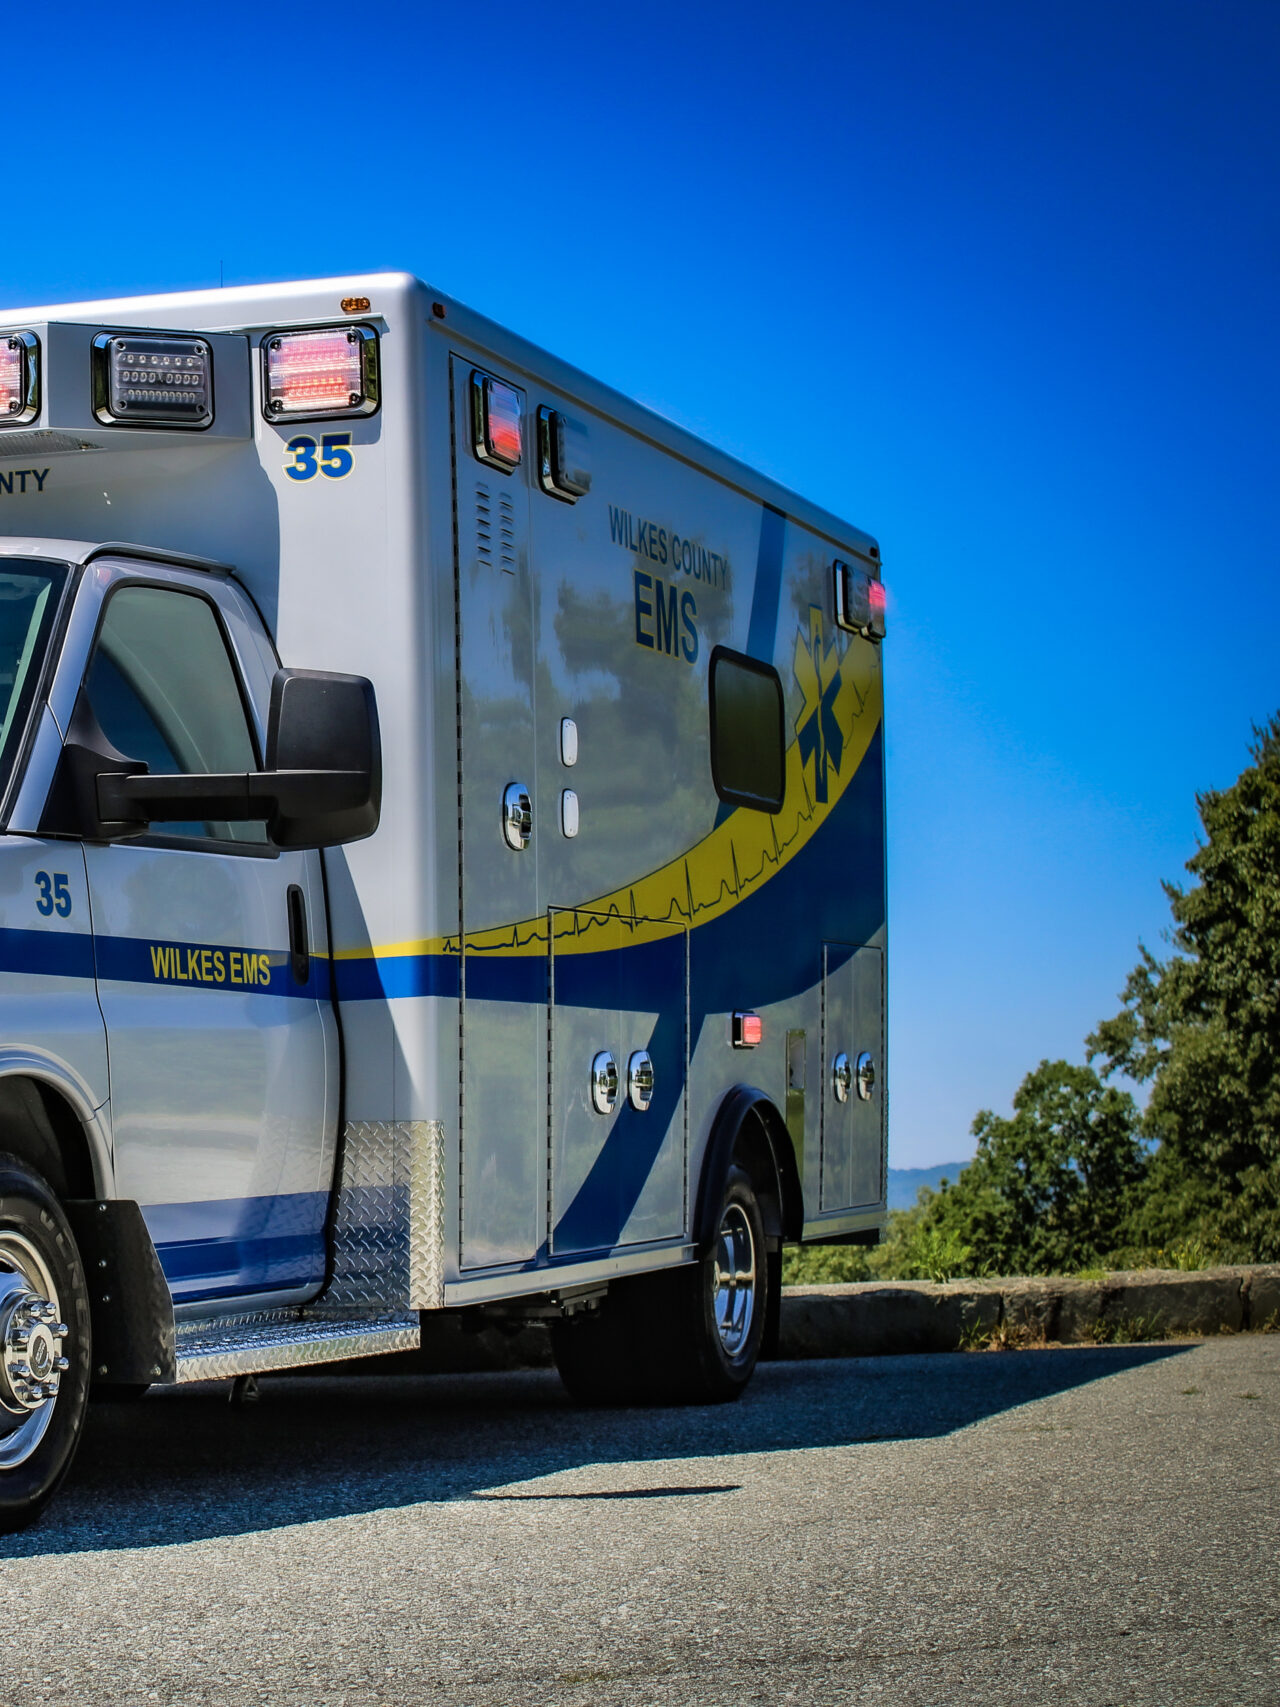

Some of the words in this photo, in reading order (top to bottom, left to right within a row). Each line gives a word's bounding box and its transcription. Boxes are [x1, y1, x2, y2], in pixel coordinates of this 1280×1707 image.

[282, 431, 355, 483] 35
[608, 504, 668, 566] WILKES
[672, 534, 729, 591] COUNTY
[633, 567, 699, 666] EMS
[34, 870, 72, 918] 35
[150, 946, 226, 983] WILKES
[230, 952, 272, 986] EMS
